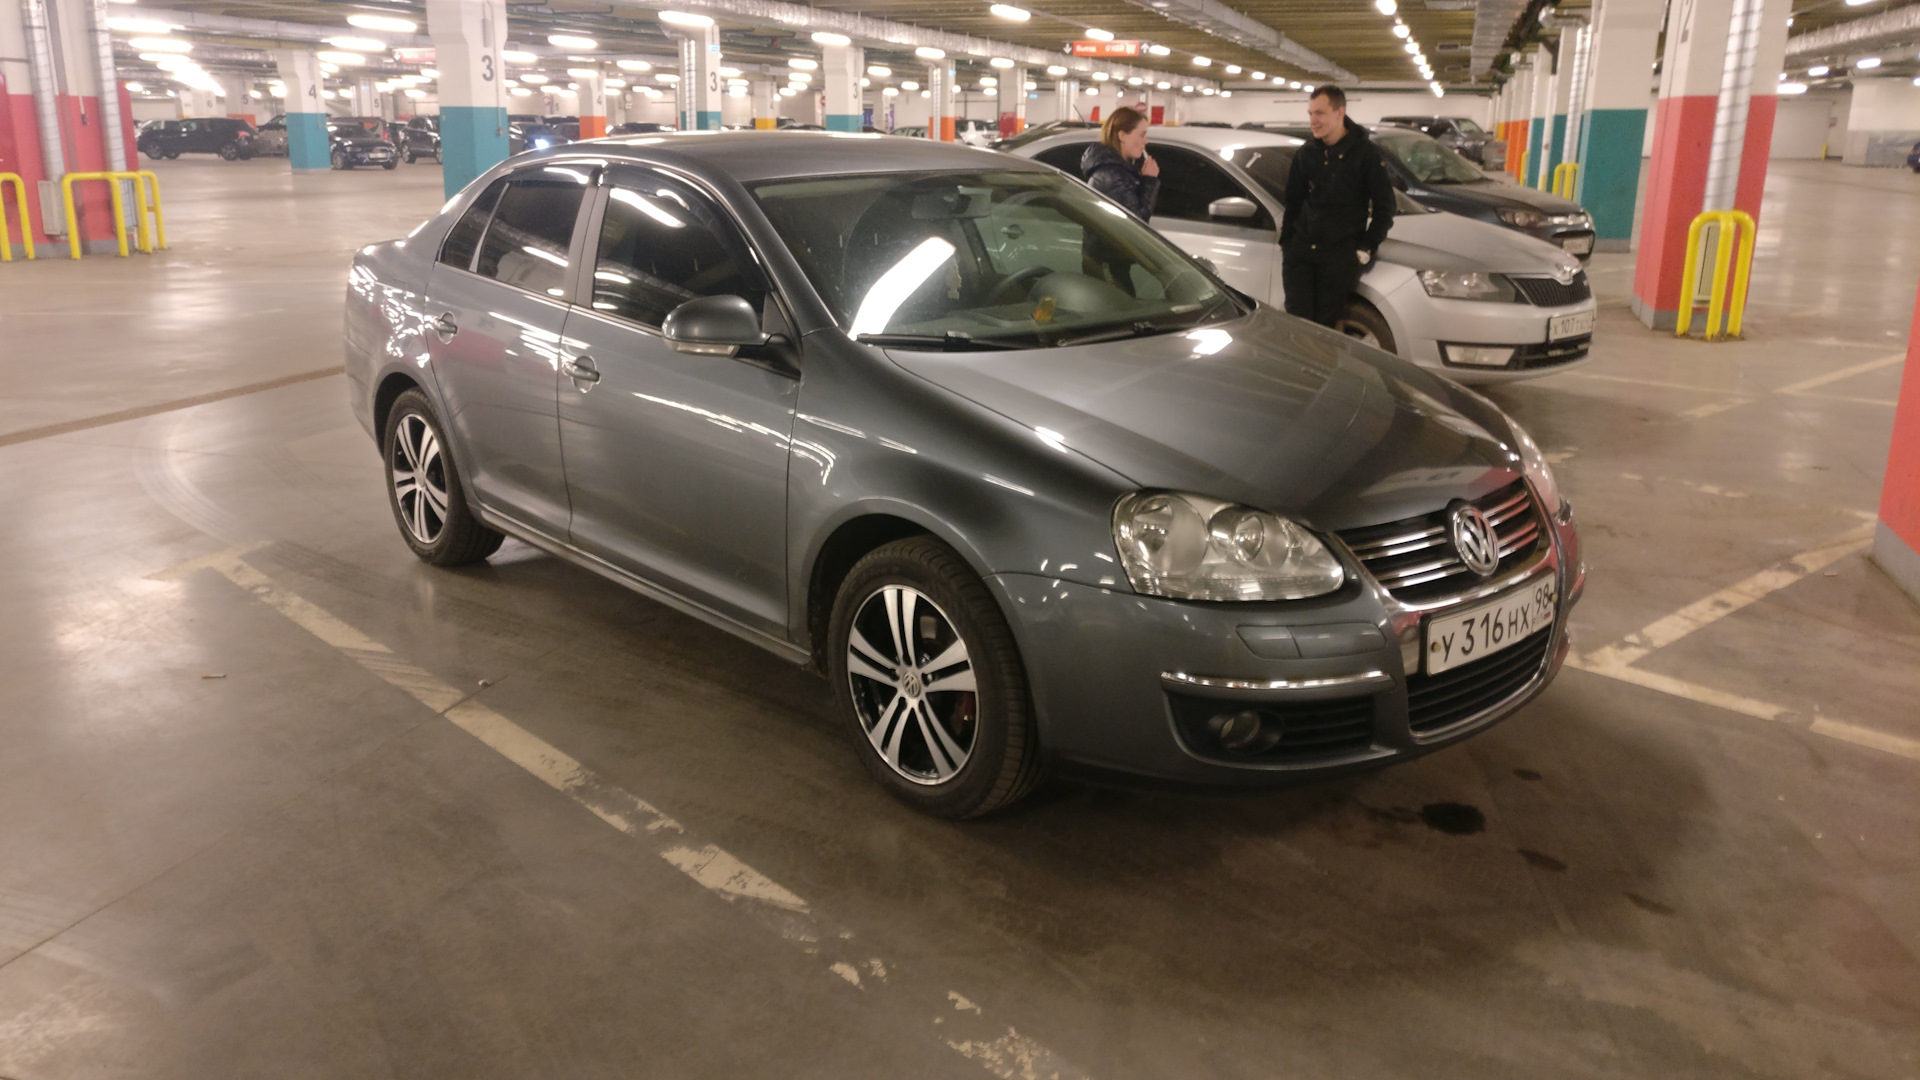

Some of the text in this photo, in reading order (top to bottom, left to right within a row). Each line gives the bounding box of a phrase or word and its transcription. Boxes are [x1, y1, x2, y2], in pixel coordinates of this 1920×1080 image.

[1681, 0, 1694, 44] 2
[481, 55, 494, 82] 3
[710, 71, 718, 92] 3
[242, 94, 249, 105] 5
[308, 84, 317, 99] 4
[596, 95, 602, 106] 4
[374, 98, 380, 108] 5
[1535, 583, 1550, 614] 98
